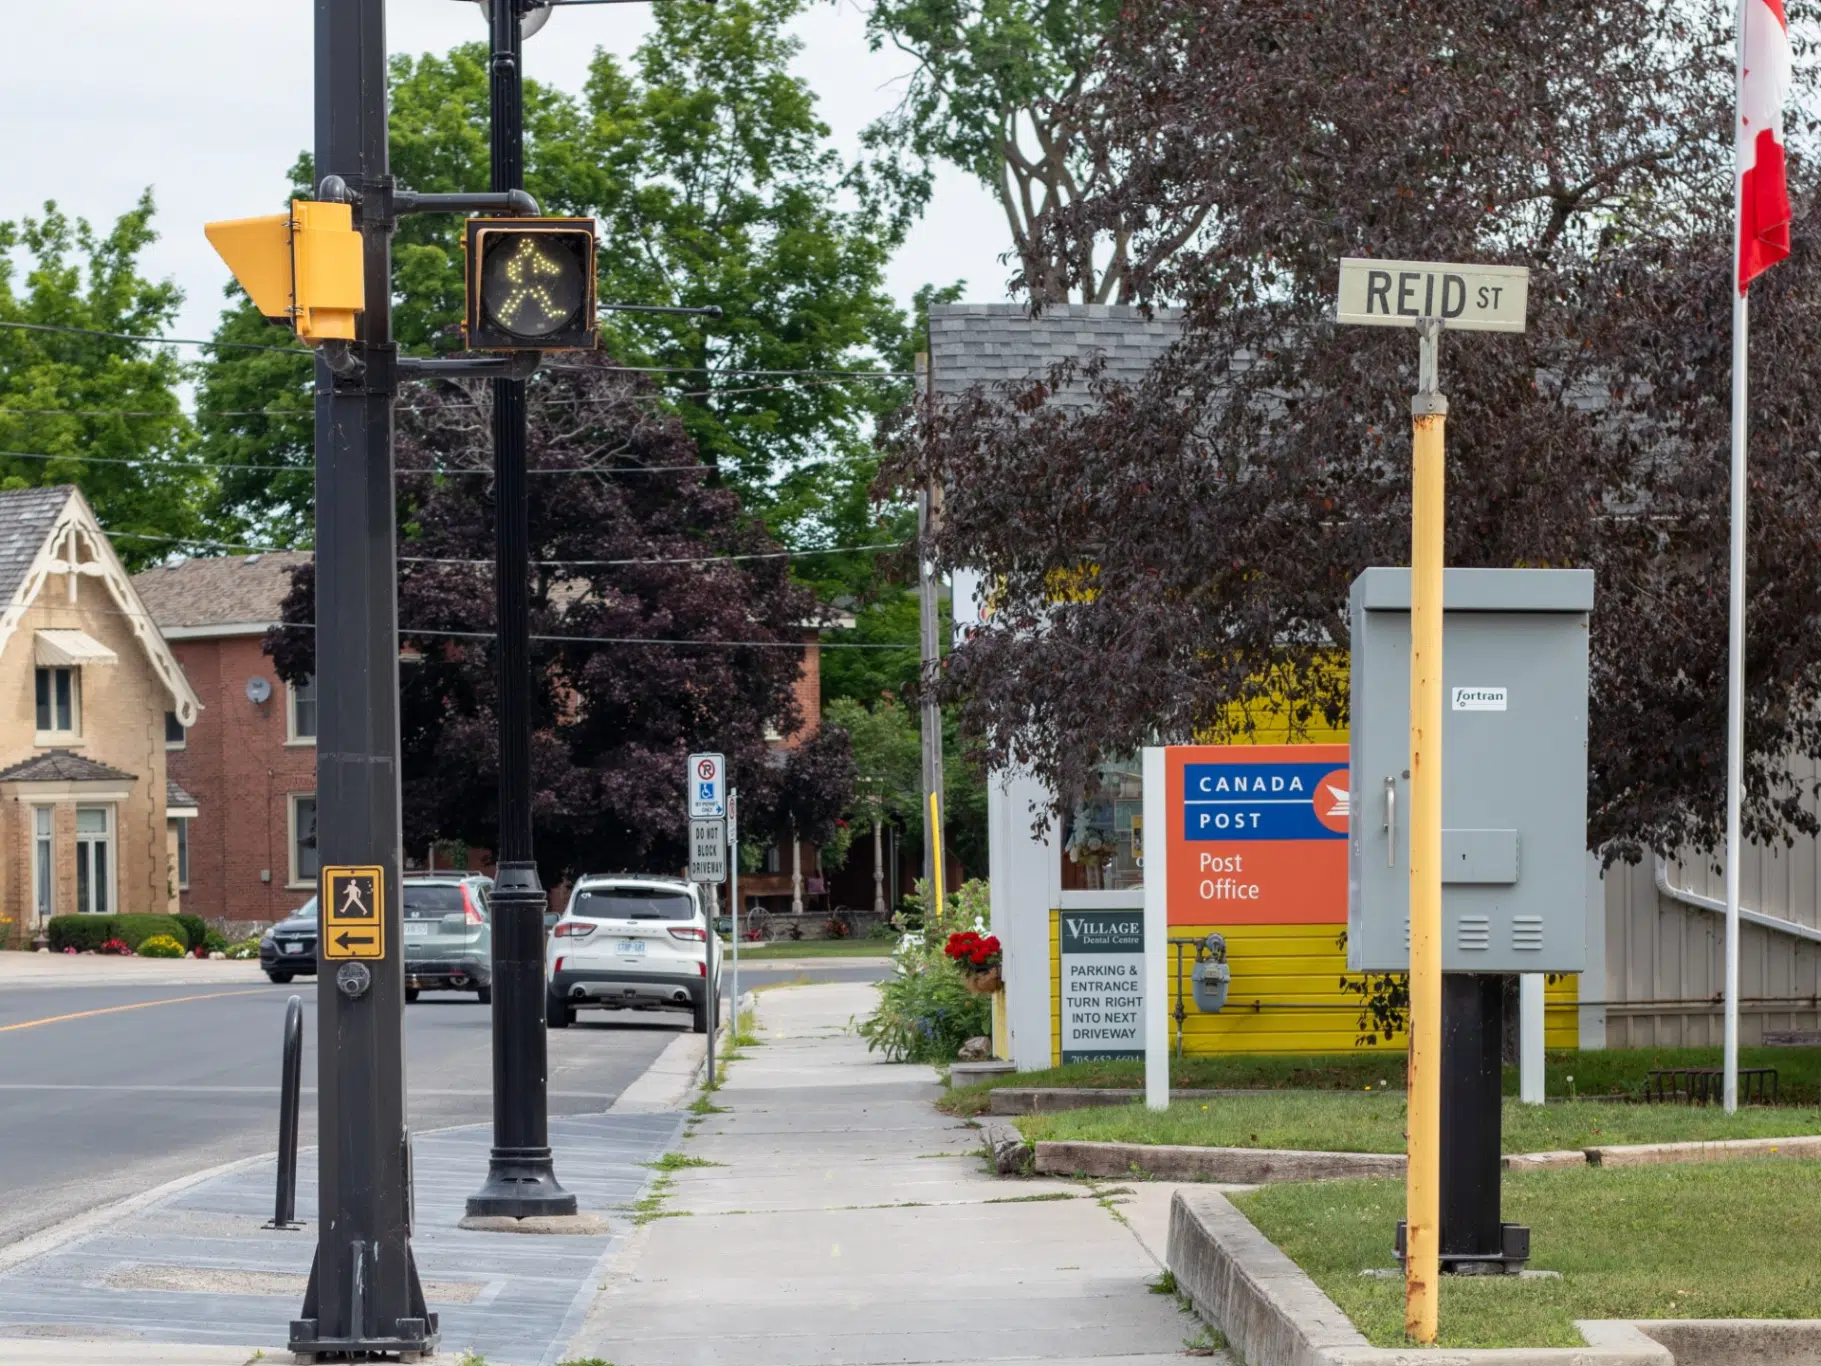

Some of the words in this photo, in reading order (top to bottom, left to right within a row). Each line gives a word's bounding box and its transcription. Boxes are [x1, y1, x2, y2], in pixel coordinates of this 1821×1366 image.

[1366, 270, 1466, 318] REID
[1476, 286, 1503, 309] ST
[1456, 689, 1504, 703] fortran
[1199, 776, 1304, 792] CANADA
[1200, 812, 1262, 829] POST
[695, 827, 705, 840] DO
[706, 827, 719, 840] NOT
[697, 844, 717, 857] BLOCK
[692, 861, 723, 875] DRIVEWAY
[1200, 852, 1243, 873] Post
[1199, 877, 1260, 900] Office
[1065, 918, 1140, 939] VILLAGE
[1083, 936, 1110, 945] Dental
[1112, 935, 1140, 944] Centre
[1071, 965, 1126, 976] PARKING
[1129, 965, 1138, 976] &
[1071, 981, 1138, 992] ENTRANCE
[1066, 997, 1100, 1008] TURN
[1105, 996, 1143, 1008] RIGHT
[1072, 1012, 1101, 1024] INTO
[1104, 1012, 1138, 1023] NEXT
[1072, 1028, 1137, 1040] DRIVEWAY
